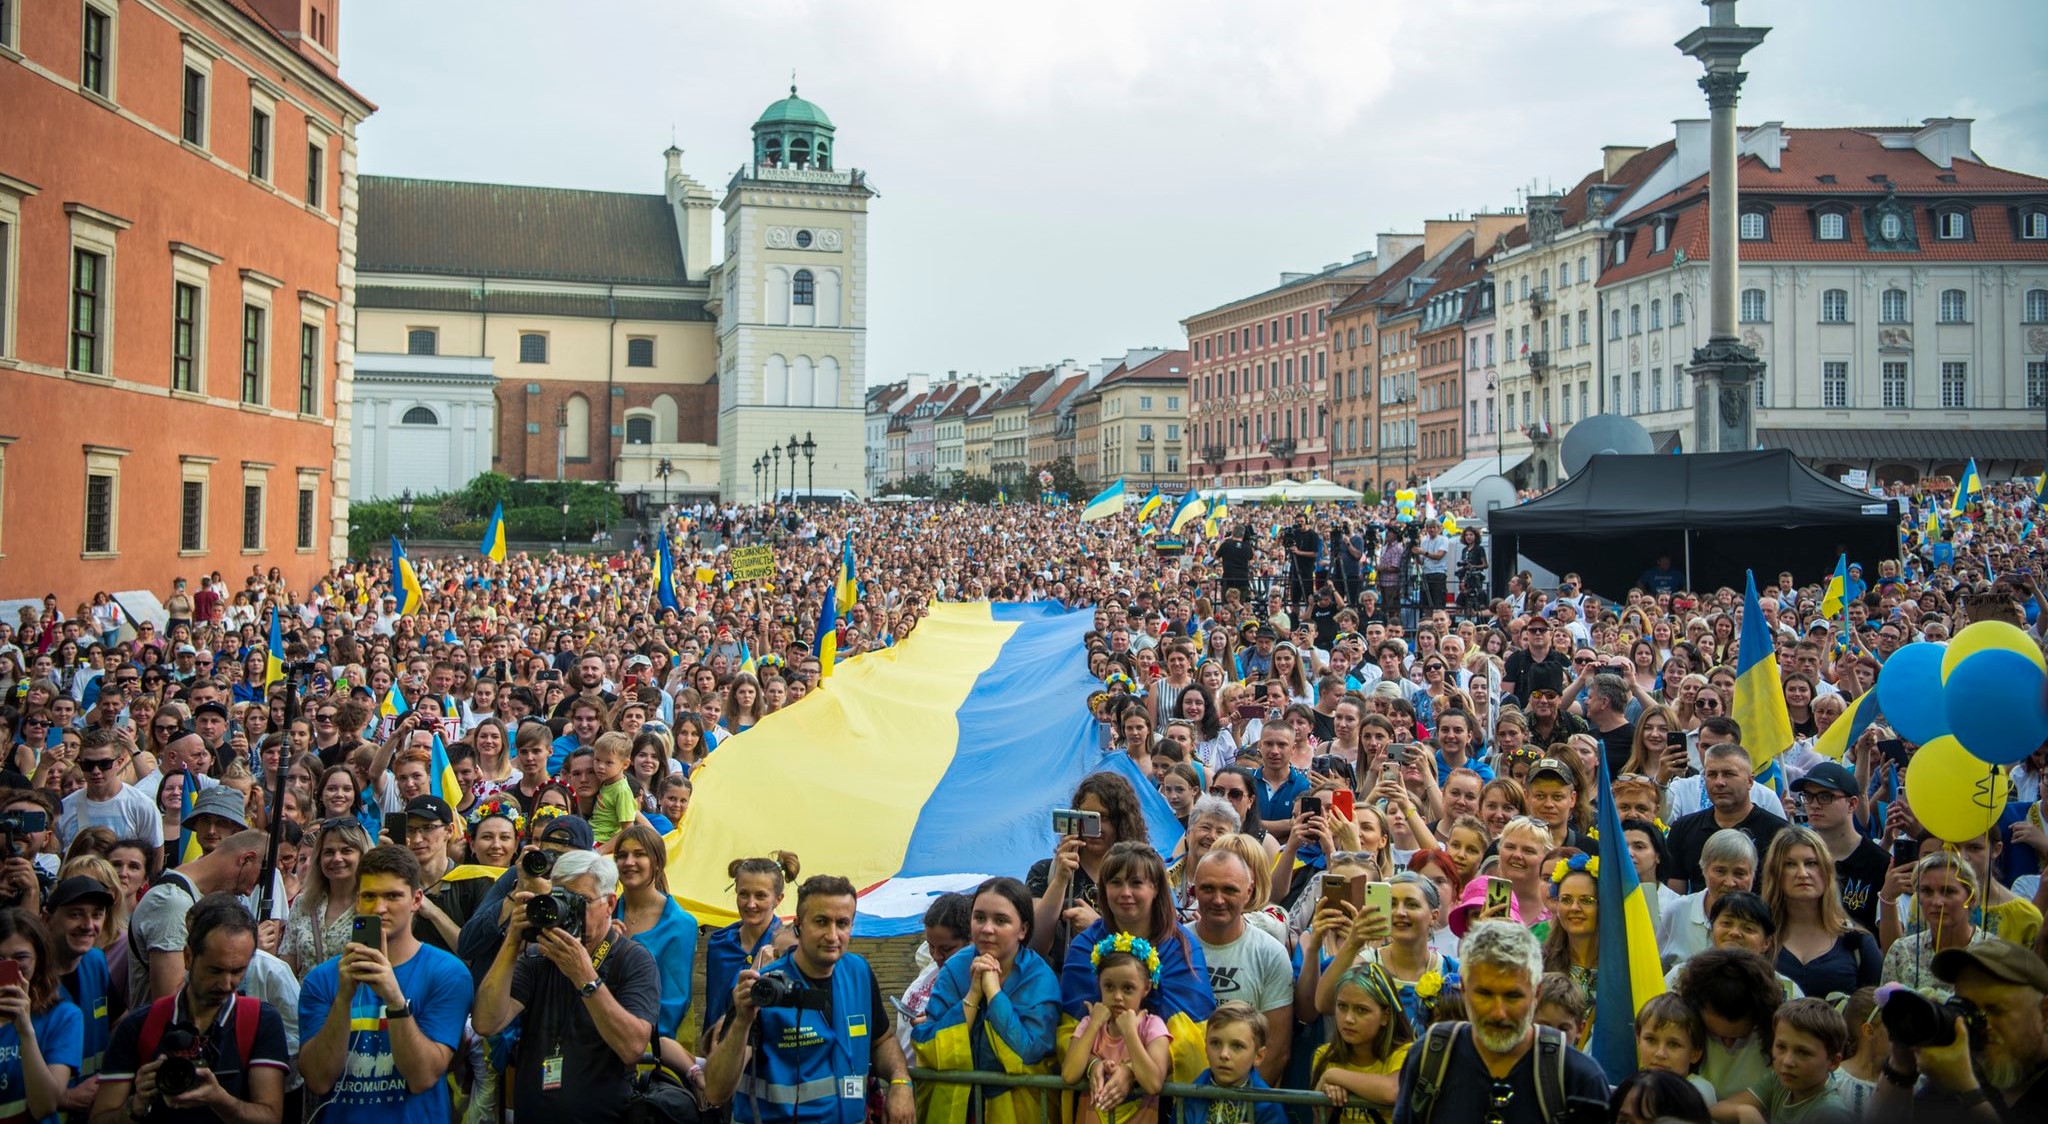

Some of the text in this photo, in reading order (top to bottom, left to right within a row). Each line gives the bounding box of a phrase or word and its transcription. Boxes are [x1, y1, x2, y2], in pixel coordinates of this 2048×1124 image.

[761, 169, 847, 180] TARAS WIDOKOWY
[334, 1080, 406, 1093] EUROMAIDAN
